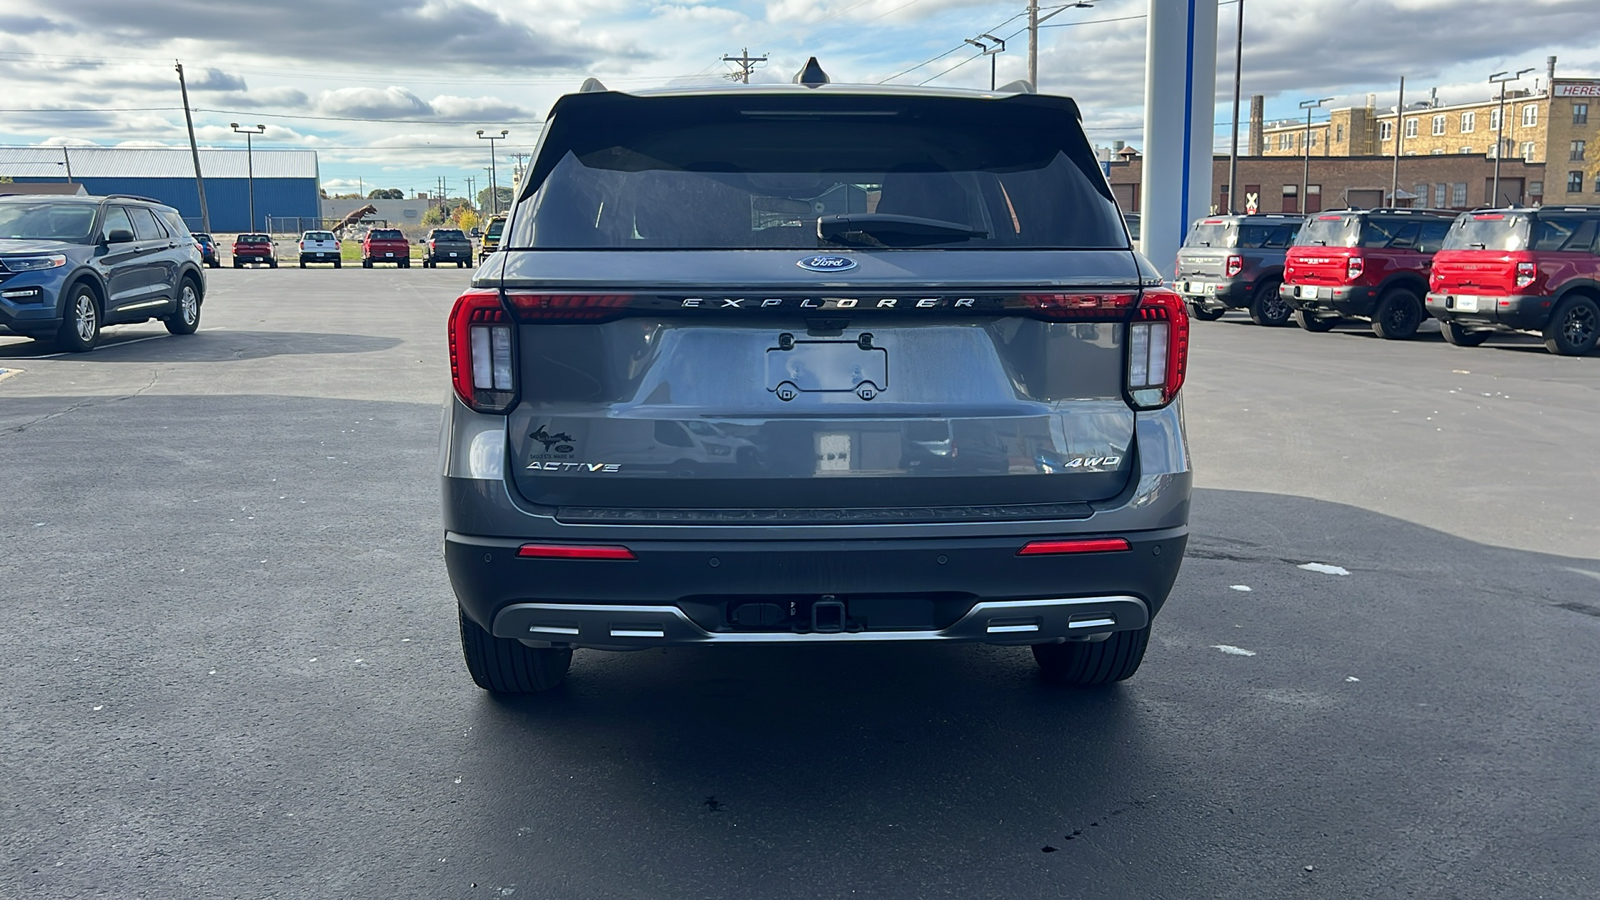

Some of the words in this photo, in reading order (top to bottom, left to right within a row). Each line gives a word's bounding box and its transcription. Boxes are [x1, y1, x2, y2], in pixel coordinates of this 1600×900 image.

[681, 298, 976, 309] EXPLORER
[526, 461, 622, 473] ACTIVE
[1064, 456, 1120, 468] 4WD
